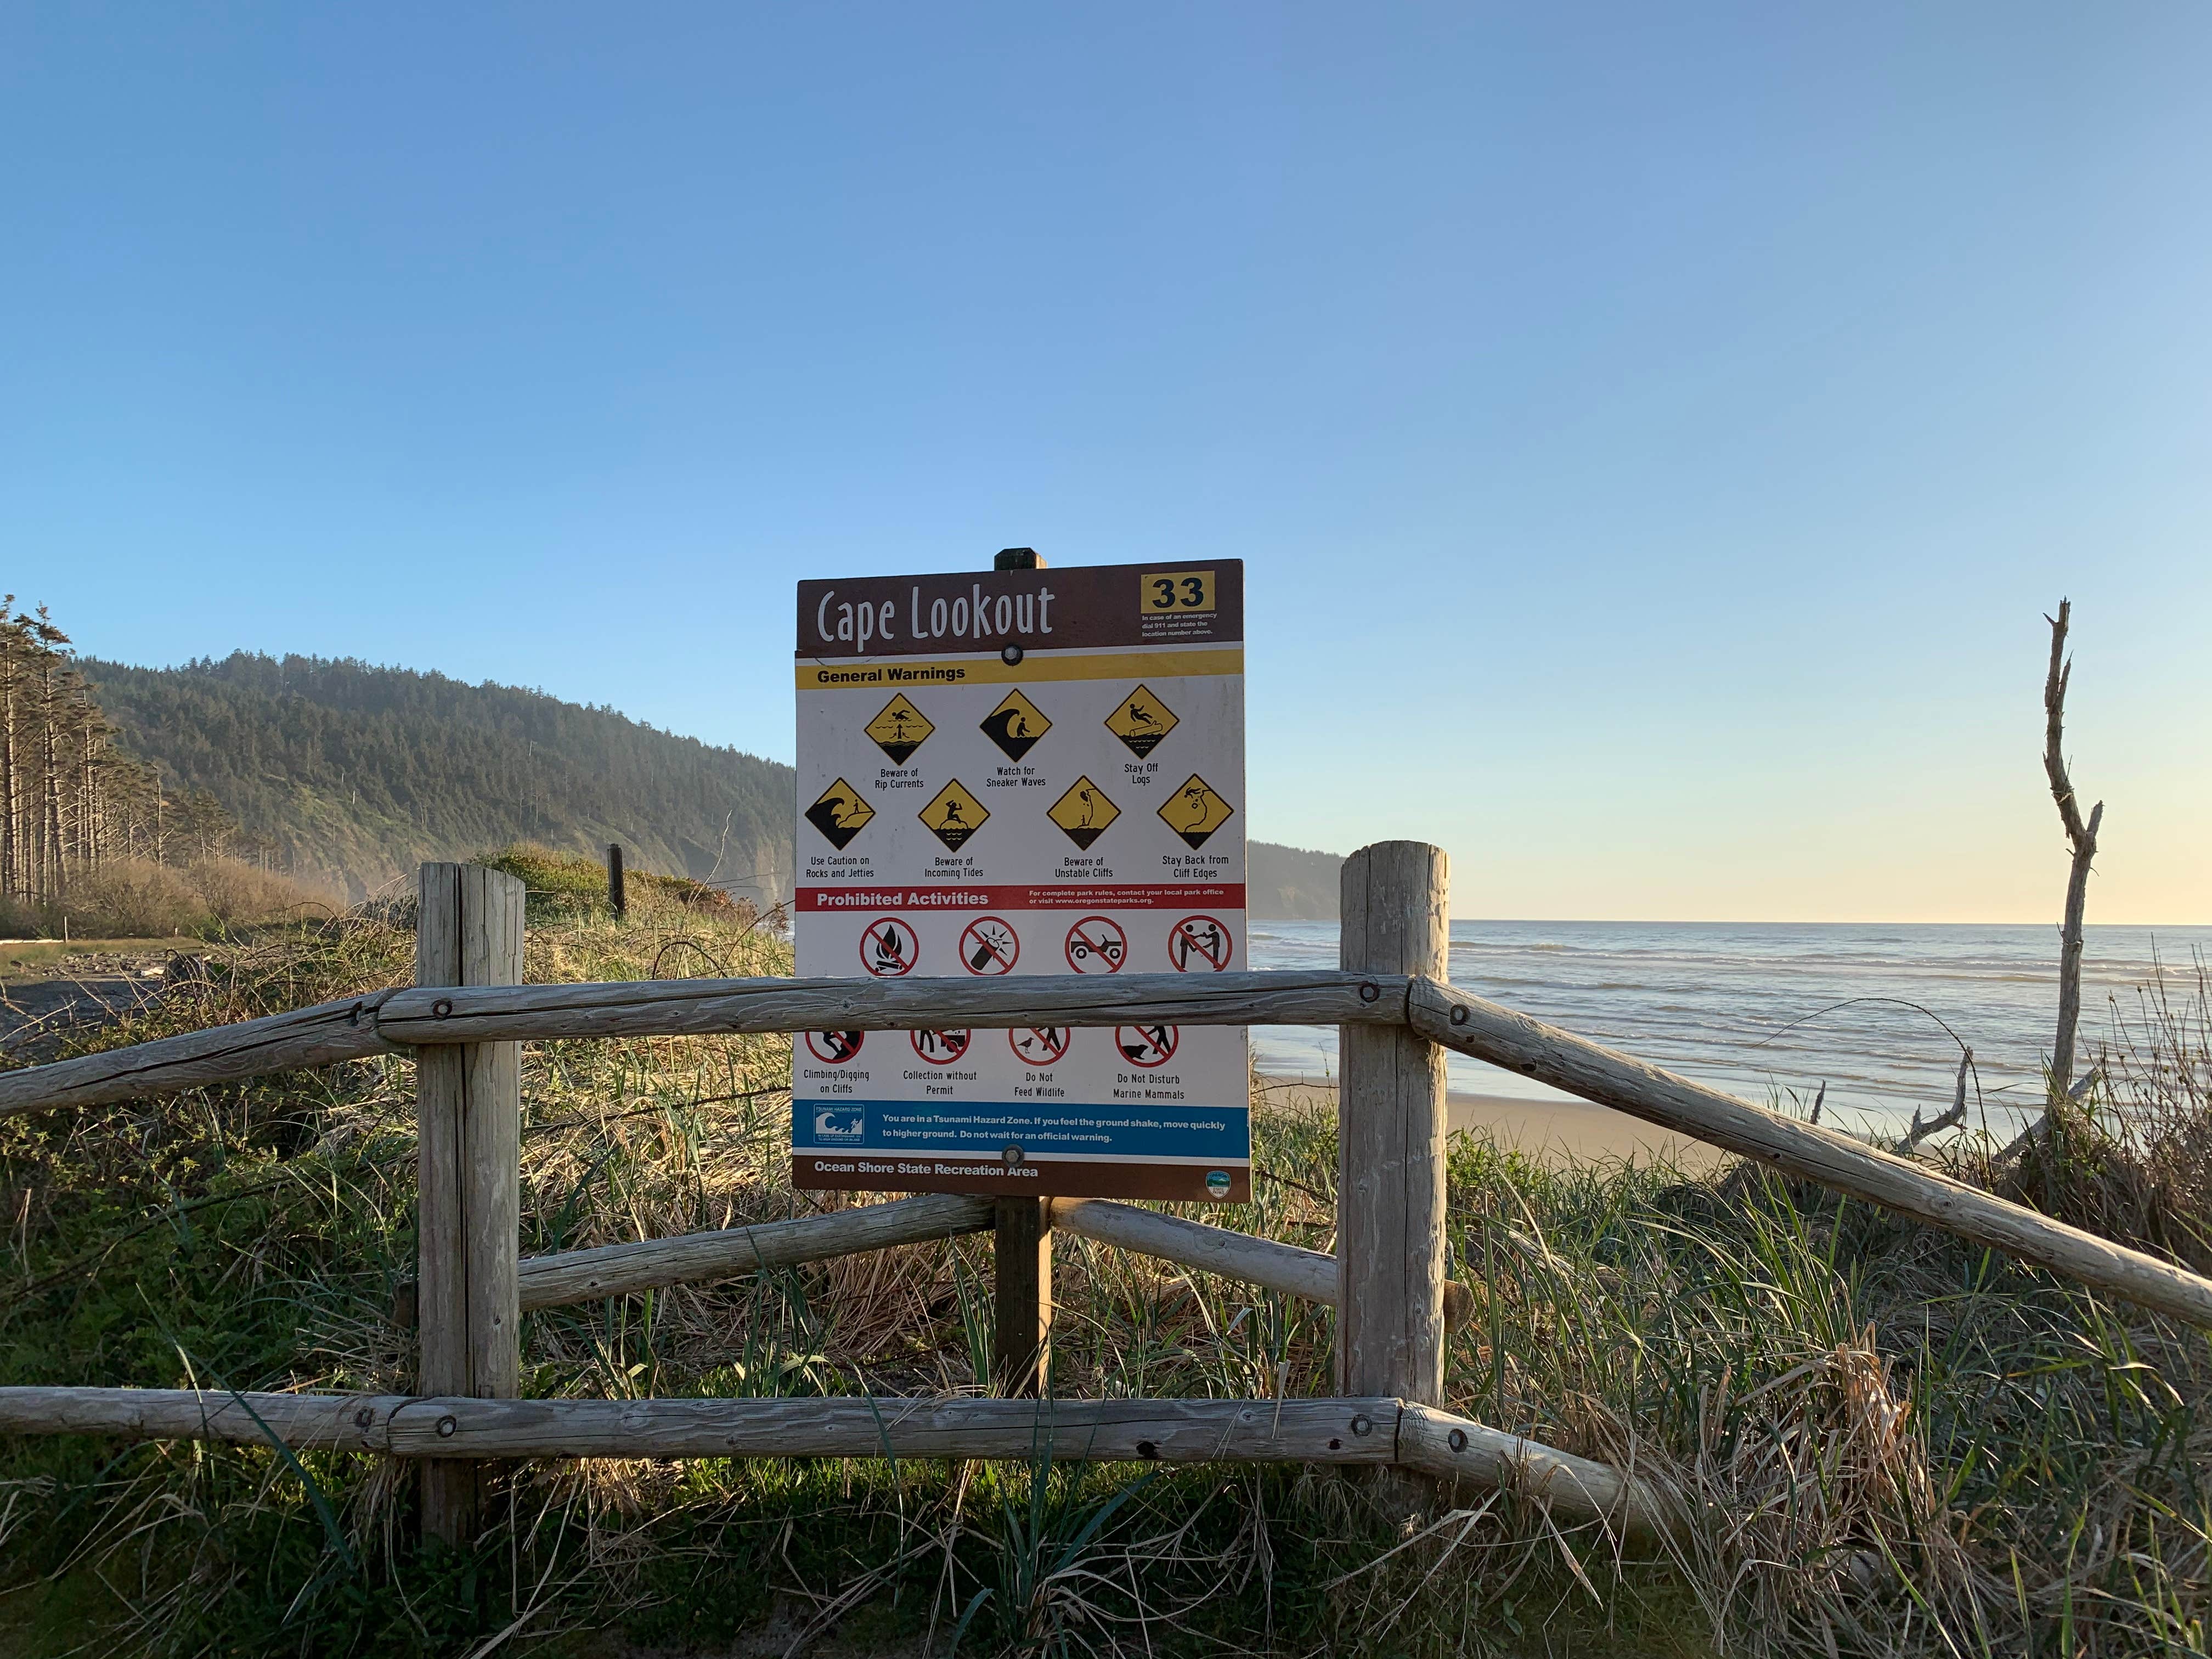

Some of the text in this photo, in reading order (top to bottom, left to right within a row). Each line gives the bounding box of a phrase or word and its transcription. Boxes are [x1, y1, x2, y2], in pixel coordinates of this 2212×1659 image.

[1152, 577, 1204, 608] 33
[817, 583, 1056, 653] Cape Lookout
[817, 667, 966, 683] General Warnings
[881, 768, 918, 777] Beware of
[997, 766, 1035, 776] Watch for
[1124, 763, 1158, 774] Stay Off
[875, 779, 924, 791] Rip Currents
[986, 777, 1046, 787] Sneaker Waves
[1132, 775, 1150, 786] Logs
[811, 856, 825, 865] Use
[828, 856, 857, 865] Caution
[935, 856, 973, 866] Beware of
[1064, 856, 1103, 866] Beware of
[1163, 855, 1229, 867] Stay Back from
[806, 868, 874, 878] Rocks and Jetties
[925, 868, 983, 879] Incoming Tides
[1055, 868, 1113, 878] Unstable Cliffs
[1173, 868, 1217, 880] Cliff Edges
[817, 892, 989, 906] Prohibited Activities
[804, 1069, 869, 1082] Climbing/Digging
[903, 1070, 977, 1080] Collection without
[1026, 1072, 1053, 1082] Do Not
[1118, 1073, 1180, 1084] Do Not Disturb
[832, 1084, 853, 1093] Cliffs
[927, 1085, 953, 1094] Permit
[1014, 1087, 1064, 1097] Feed Wildlife
[1113, 1088, 1184, 1099] Marine Mammals
[1007, 1116, 1032, 1125] Zone.
[1096, 1119, 1129, 1128] ground
[1130, 1119, 1161, 1129] shake,
[1190, 1121, 1225, 1131] quickly
[893, 1129, 922, 1138] higher
[922, 1130, 957, 1139] ground.
[1071, 1133, 1112, 1143] warning.
[815, 1161, 1039, 1177] Ocean Shore State Recreation Area
